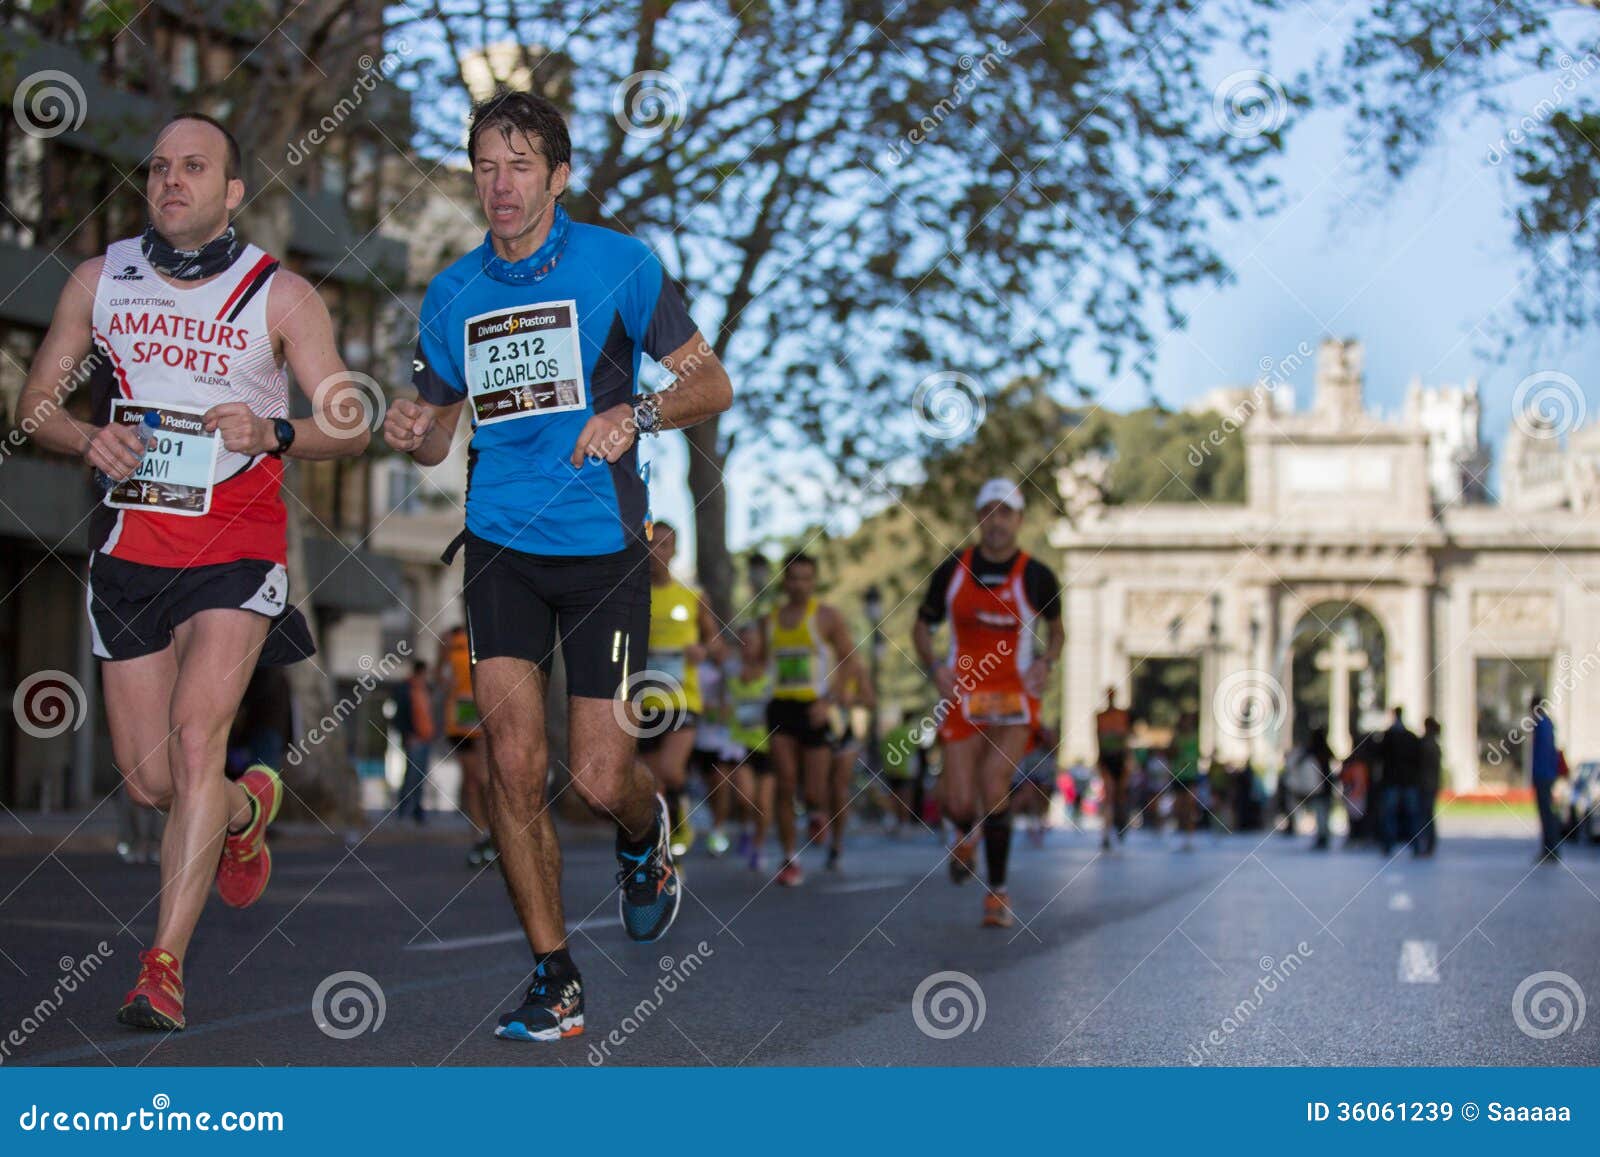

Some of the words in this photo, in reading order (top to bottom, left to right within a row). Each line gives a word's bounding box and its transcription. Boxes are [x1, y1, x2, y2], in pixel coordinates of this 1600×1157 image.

[110, 298, 130, 306] CLUB
[131, 298, 175, 308] ATLETISMO
[109, 312, 249, 350] AMATEURS
[478, 321, 503, 337] Divina
[519, 315, 556, 330] Pastora
[132, 342, 231, 376] SPORTS
[488, 337, 545, 363] 2.312
[194, 376, 231, 387] VALENCIA
[482, 359, 559, 389] J.CARLOS
[123, 411, 145, 424] Divin
[165, 415, 202, 431] Pastora
[135, 458, 169, 478] JAVI
